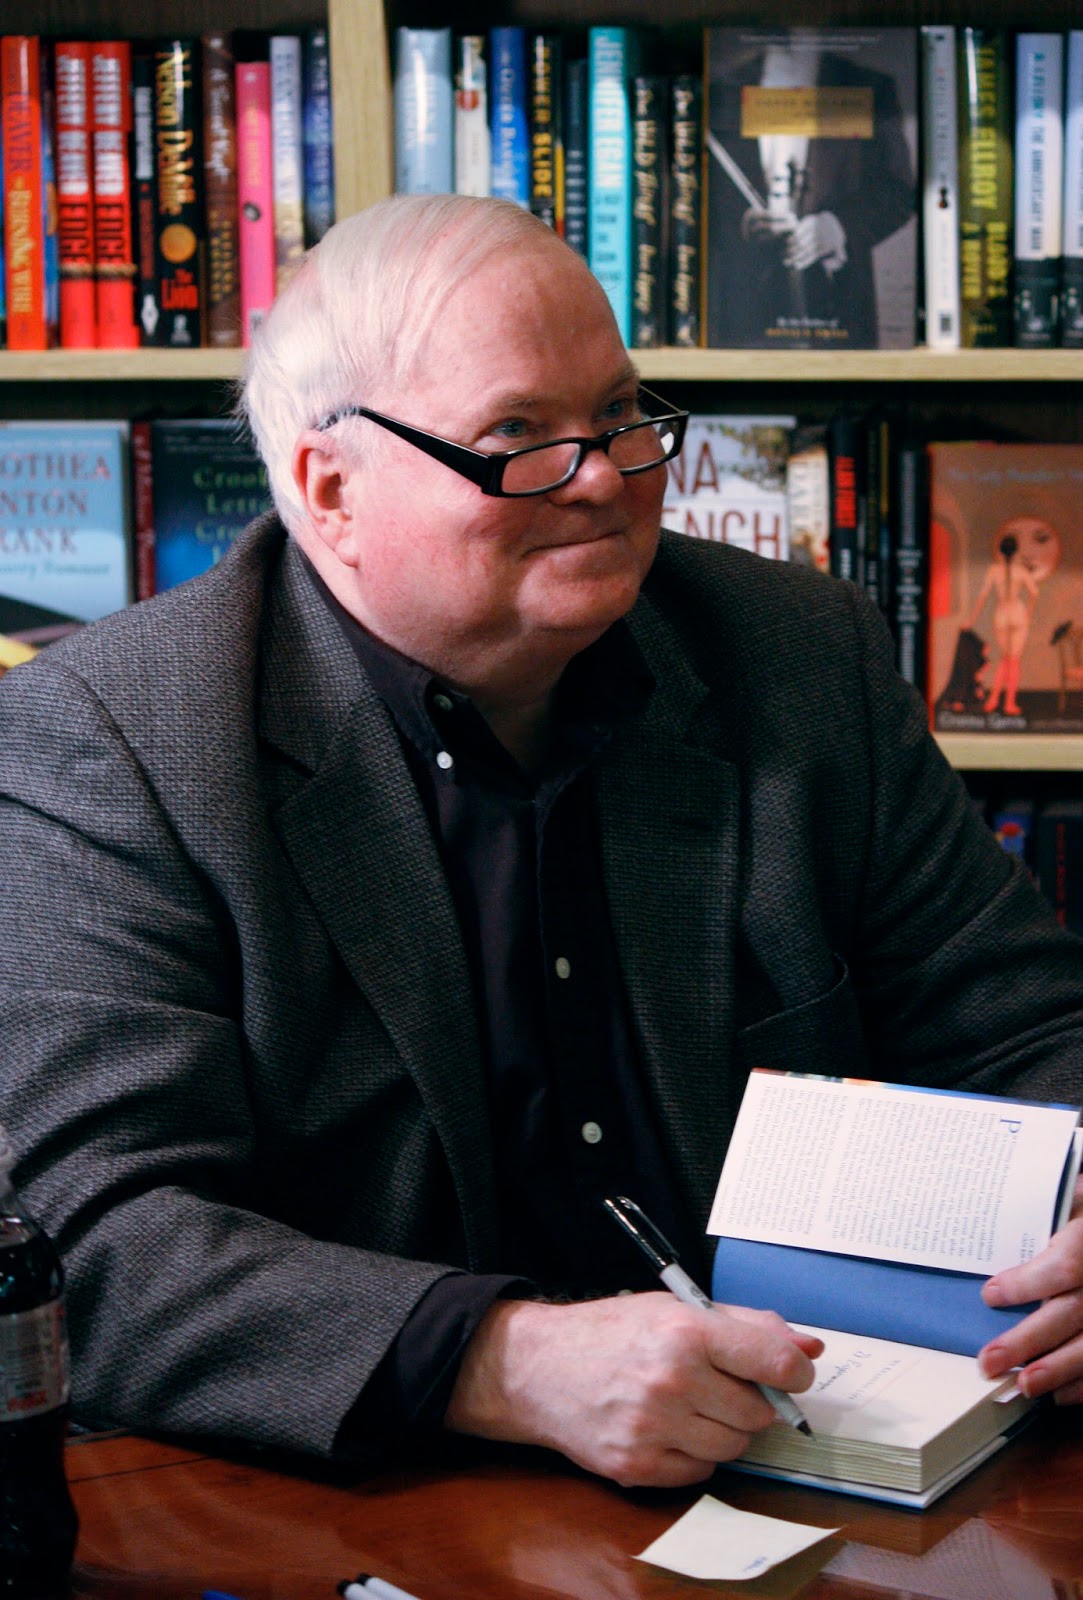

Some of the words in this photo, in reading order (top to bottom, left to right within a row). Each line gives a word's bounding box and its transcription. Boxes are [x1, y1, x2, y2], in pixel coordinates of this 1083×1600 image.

[594, 36, 624, 131] JENNIFER
[533, 132, 552, 198] SLIDE
[593, 138, 624, 187] EGAN
[60, 203, 90, 264] EDGE
[96, 203, 124, 264] EDGE
